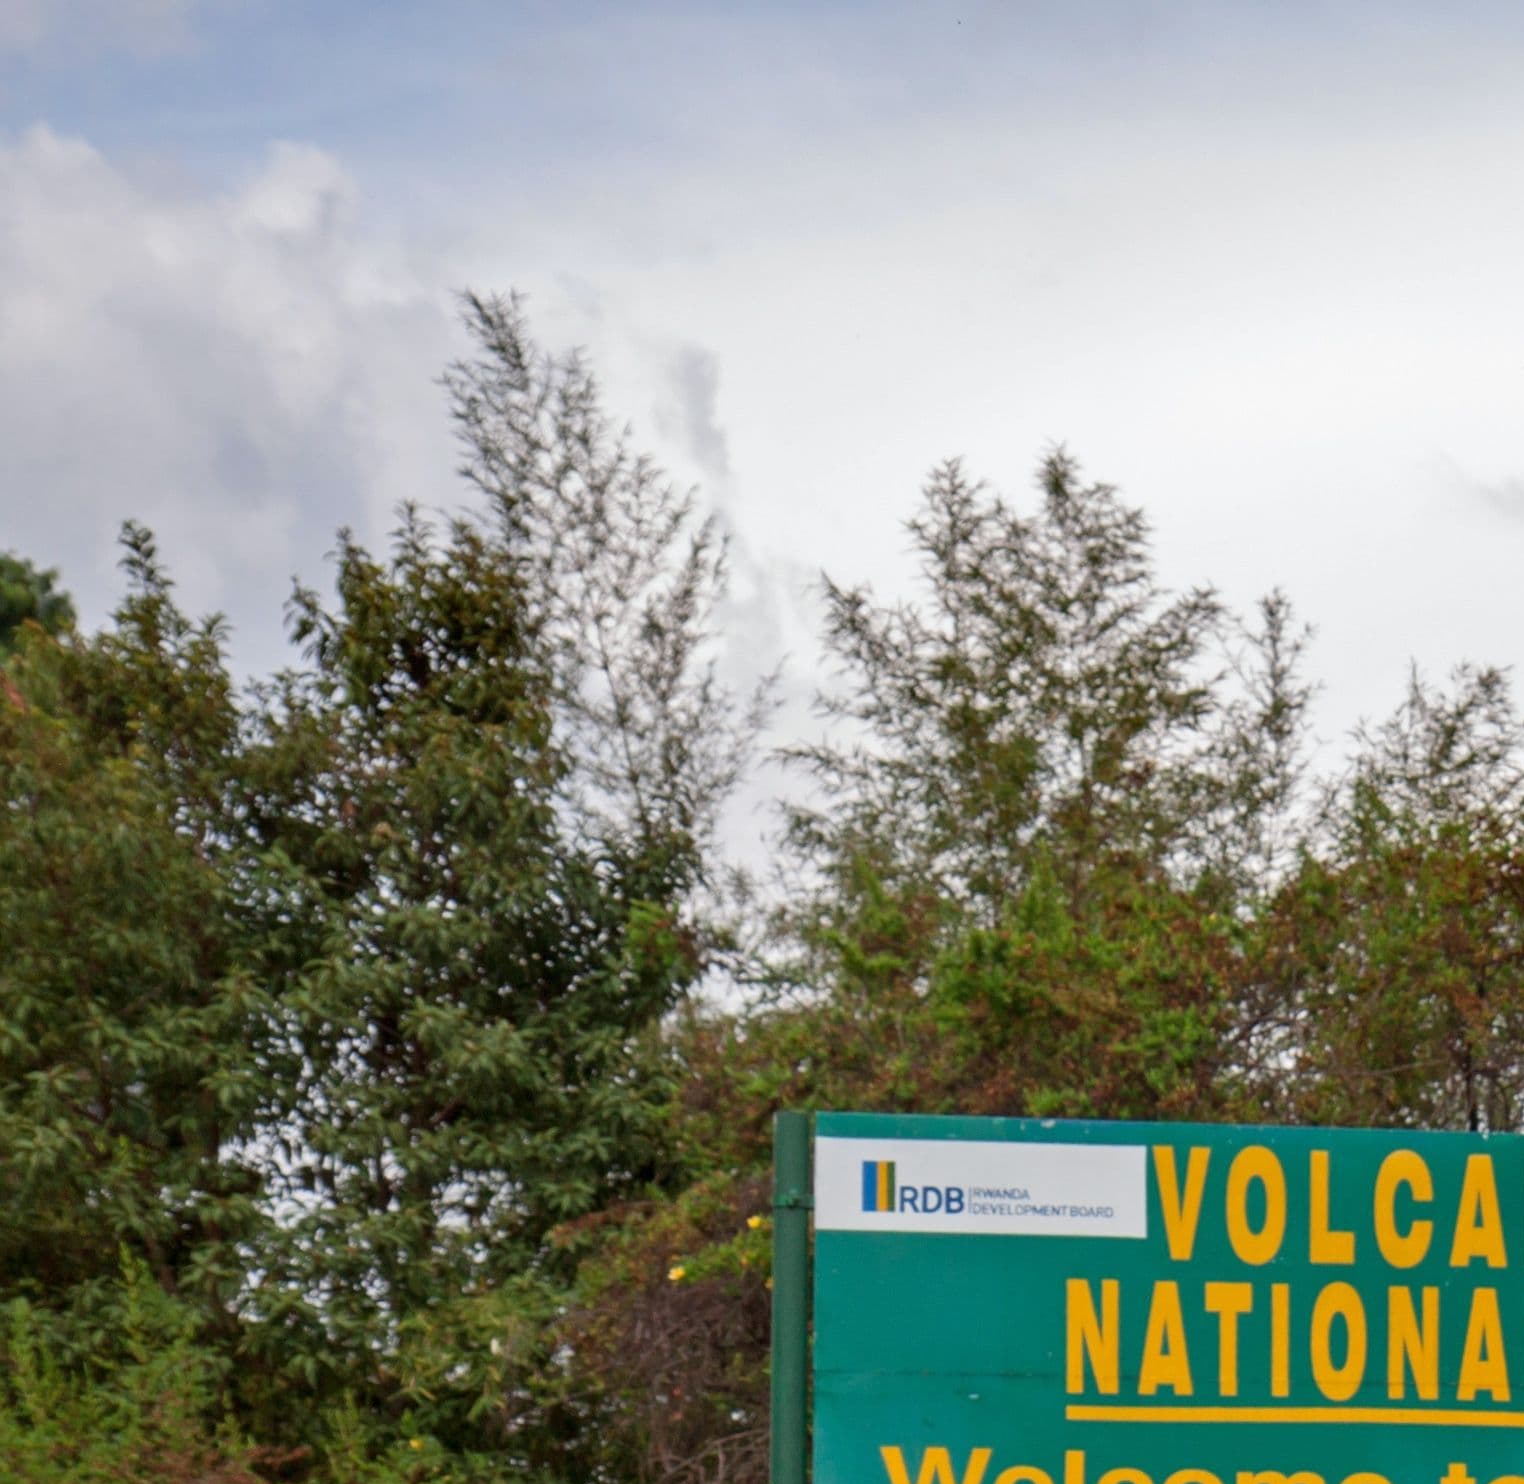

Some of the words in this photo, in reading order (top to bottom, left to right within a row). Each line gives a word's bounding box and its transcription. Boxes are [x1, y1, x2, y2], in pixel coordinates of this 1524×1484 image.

[899, 1186, 965, 1214] RDB
[973, 1188, 1031, 1200] RWANDA
[973, 1203, 1067, 1217] DEVELOPMENT
[1070, 1205, 1114, 1218] BOARD
